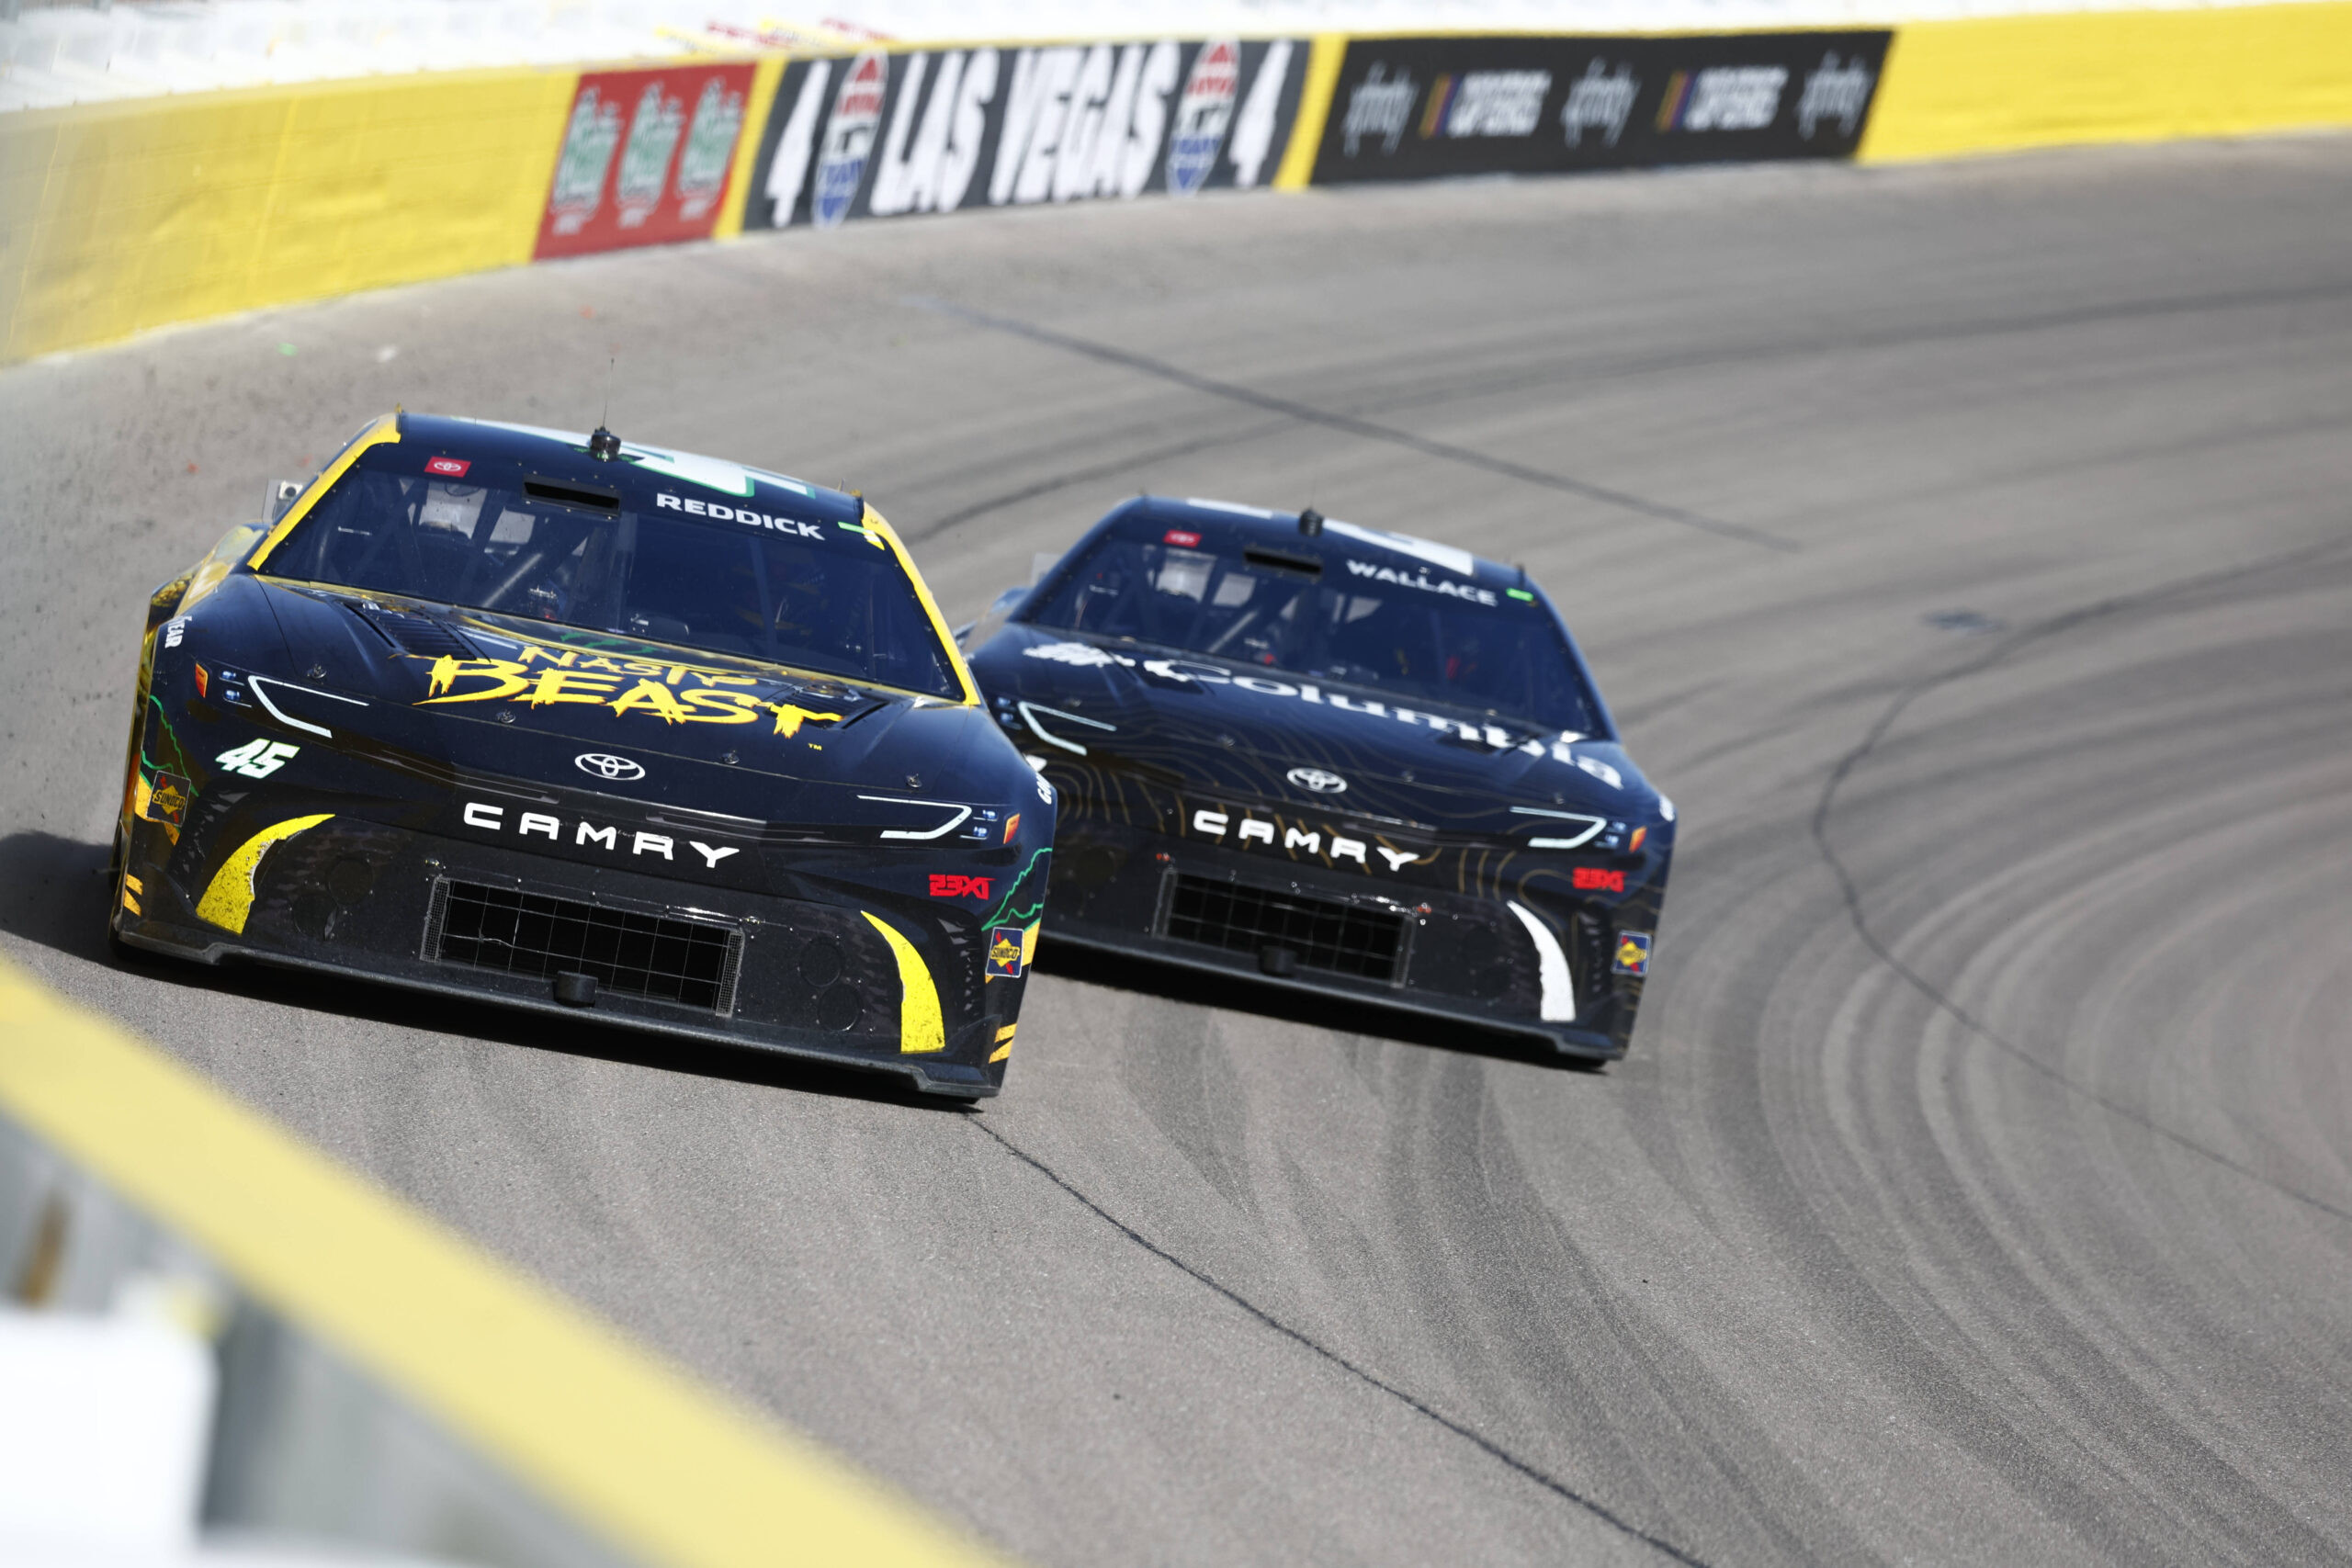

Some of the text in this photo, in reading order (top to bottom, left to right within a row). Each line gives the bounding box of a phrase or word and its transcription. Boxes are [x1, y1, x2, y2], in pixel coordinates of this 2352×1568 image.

[765, 59, 831, 227] 4
[869, 47, 1000, 215] LAS
[989, 41, 1180, 204] VEGAS
[1228, 39, 1293, 187] 4
[656, 492, 826, 540] REDDICK
[1346, 558, 1499, 607] WALLACE
[517, 645, 759, 687] NASTY
[409, 654, 844, 739] BEAST
[1143, 659, 1624, 791] Columbia
[214, 737, 301, 780] 45
[152, 791, 186, 810] SUNOCO
[463, 802, 741, 869] CAMRY
[1193, 809, 1420, 872] CAMRY
[990, 946, 1020, 960] SUNOCO
